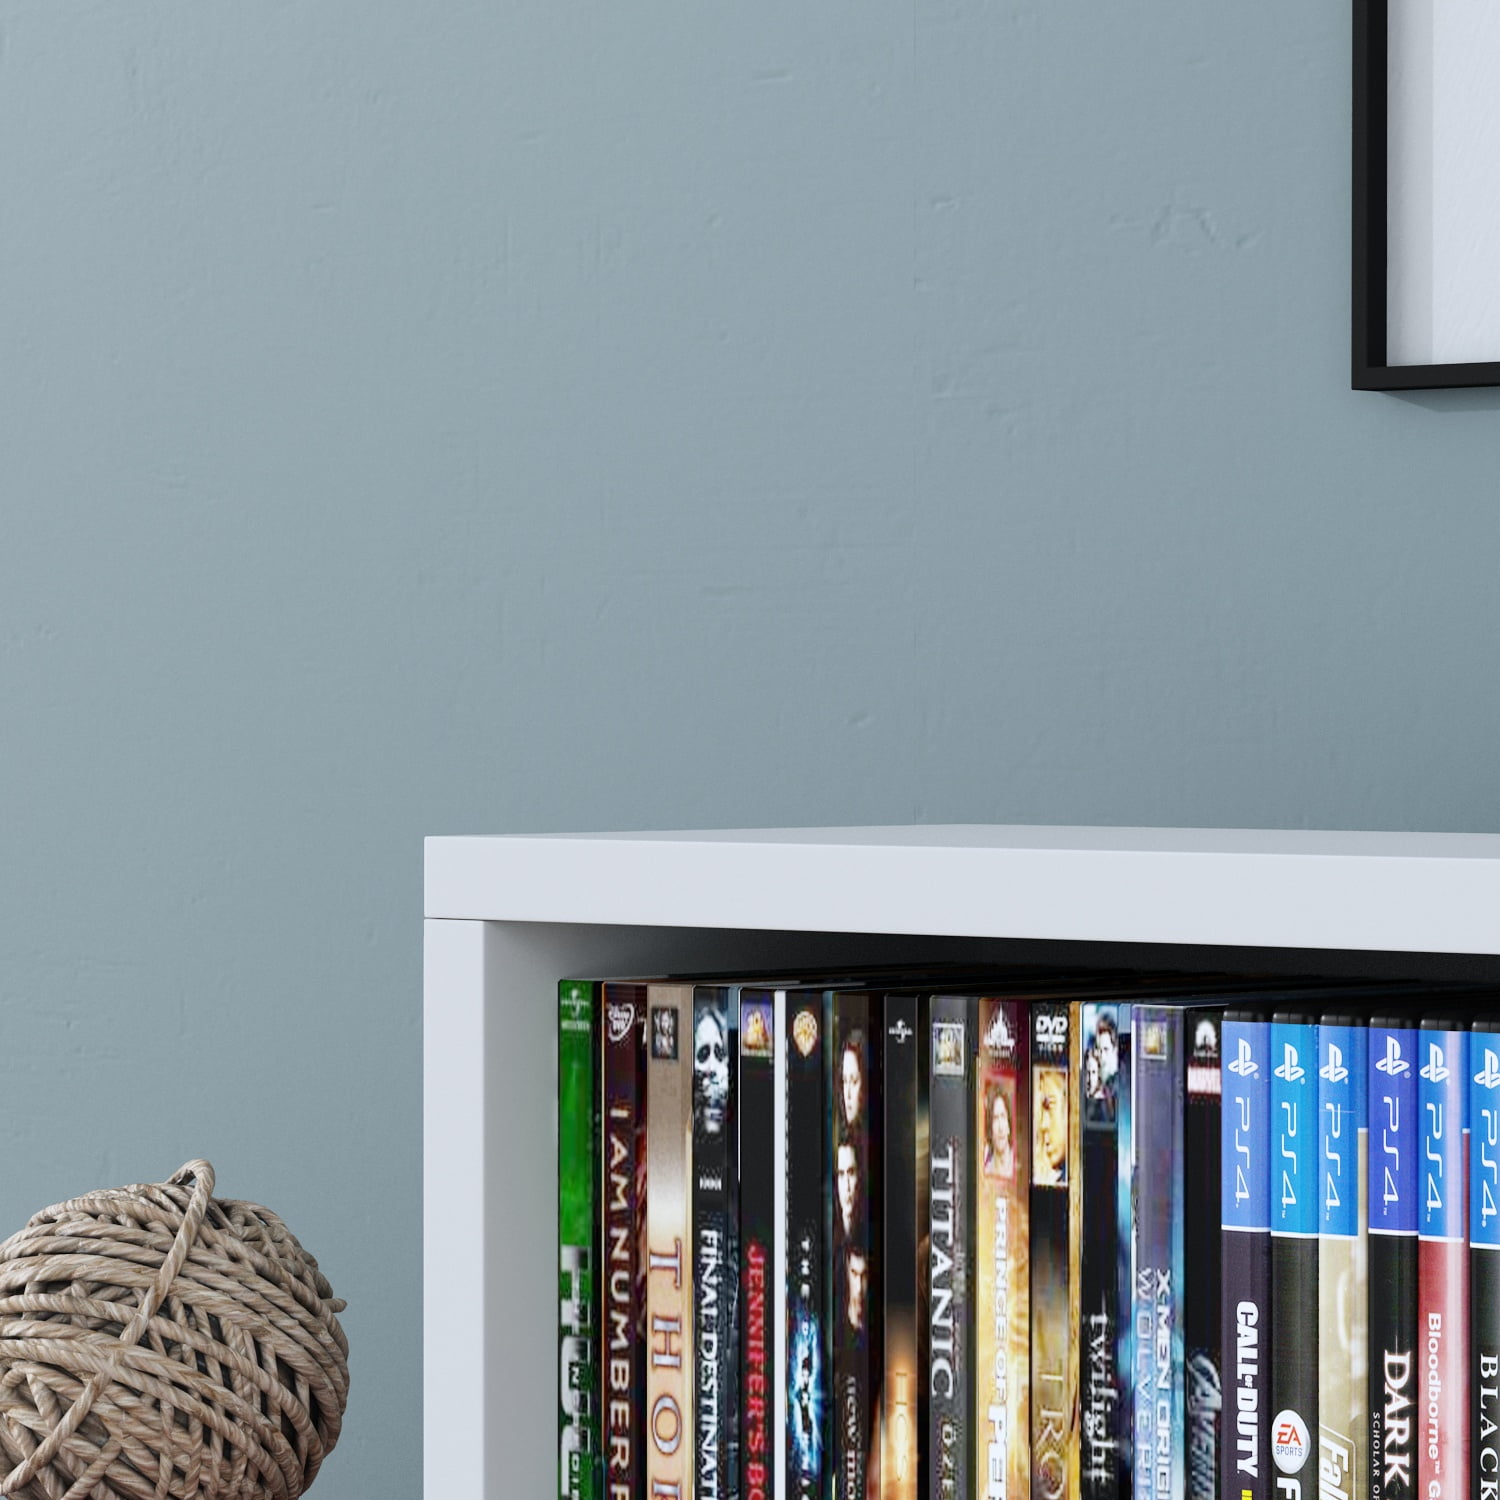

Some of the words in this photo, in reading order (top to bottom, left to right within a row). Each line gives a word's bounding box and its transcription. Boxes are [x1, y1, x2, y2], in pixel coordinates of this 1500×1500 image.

[610, 1108, 629, 1117] I
[1235, 1096, 1250, 1204] PS4
[1281, 1102, 1297, 1208] PS4
[1325, 1102, 1341, 1211] PS4
[1383, 1096, 1399, 1209] PS4
[1426, 1102, 1443, 1213] PS4
[1481, 1109, 1498, 1221] PS4
[610, 1133, 629, 1210] AM
[701, 1229, 719, 1324] FINAL
[932, 1145, 953, 1398] TITANIC
[995, 1197, 1007, 1340] PRINCE
[609, 1227, 630, 1469] NUMBER
[748, 1239, 766, 1457] JENNIFER'S
[995, 1349, 1007, 1401] OF
[1156, 1269, 1171, 1390] X-MEN
[1236, 1301, 1258, 1380] CALL
[846, 1376, 857, 1444] new
[1084, 1310, 1118, 1485] twilight
[1236, 1387, 1258, 1478] DUTY
[1277, 1423, 1301, 1446] EA
[1372, 1411, 1380, 1477] SCHOLAR
[1384, 1349, 1411, 1488] DARK
[1276, 1446, 1303, 1457] SPORTS
[1372, 1484, 1380, 1500] OF
